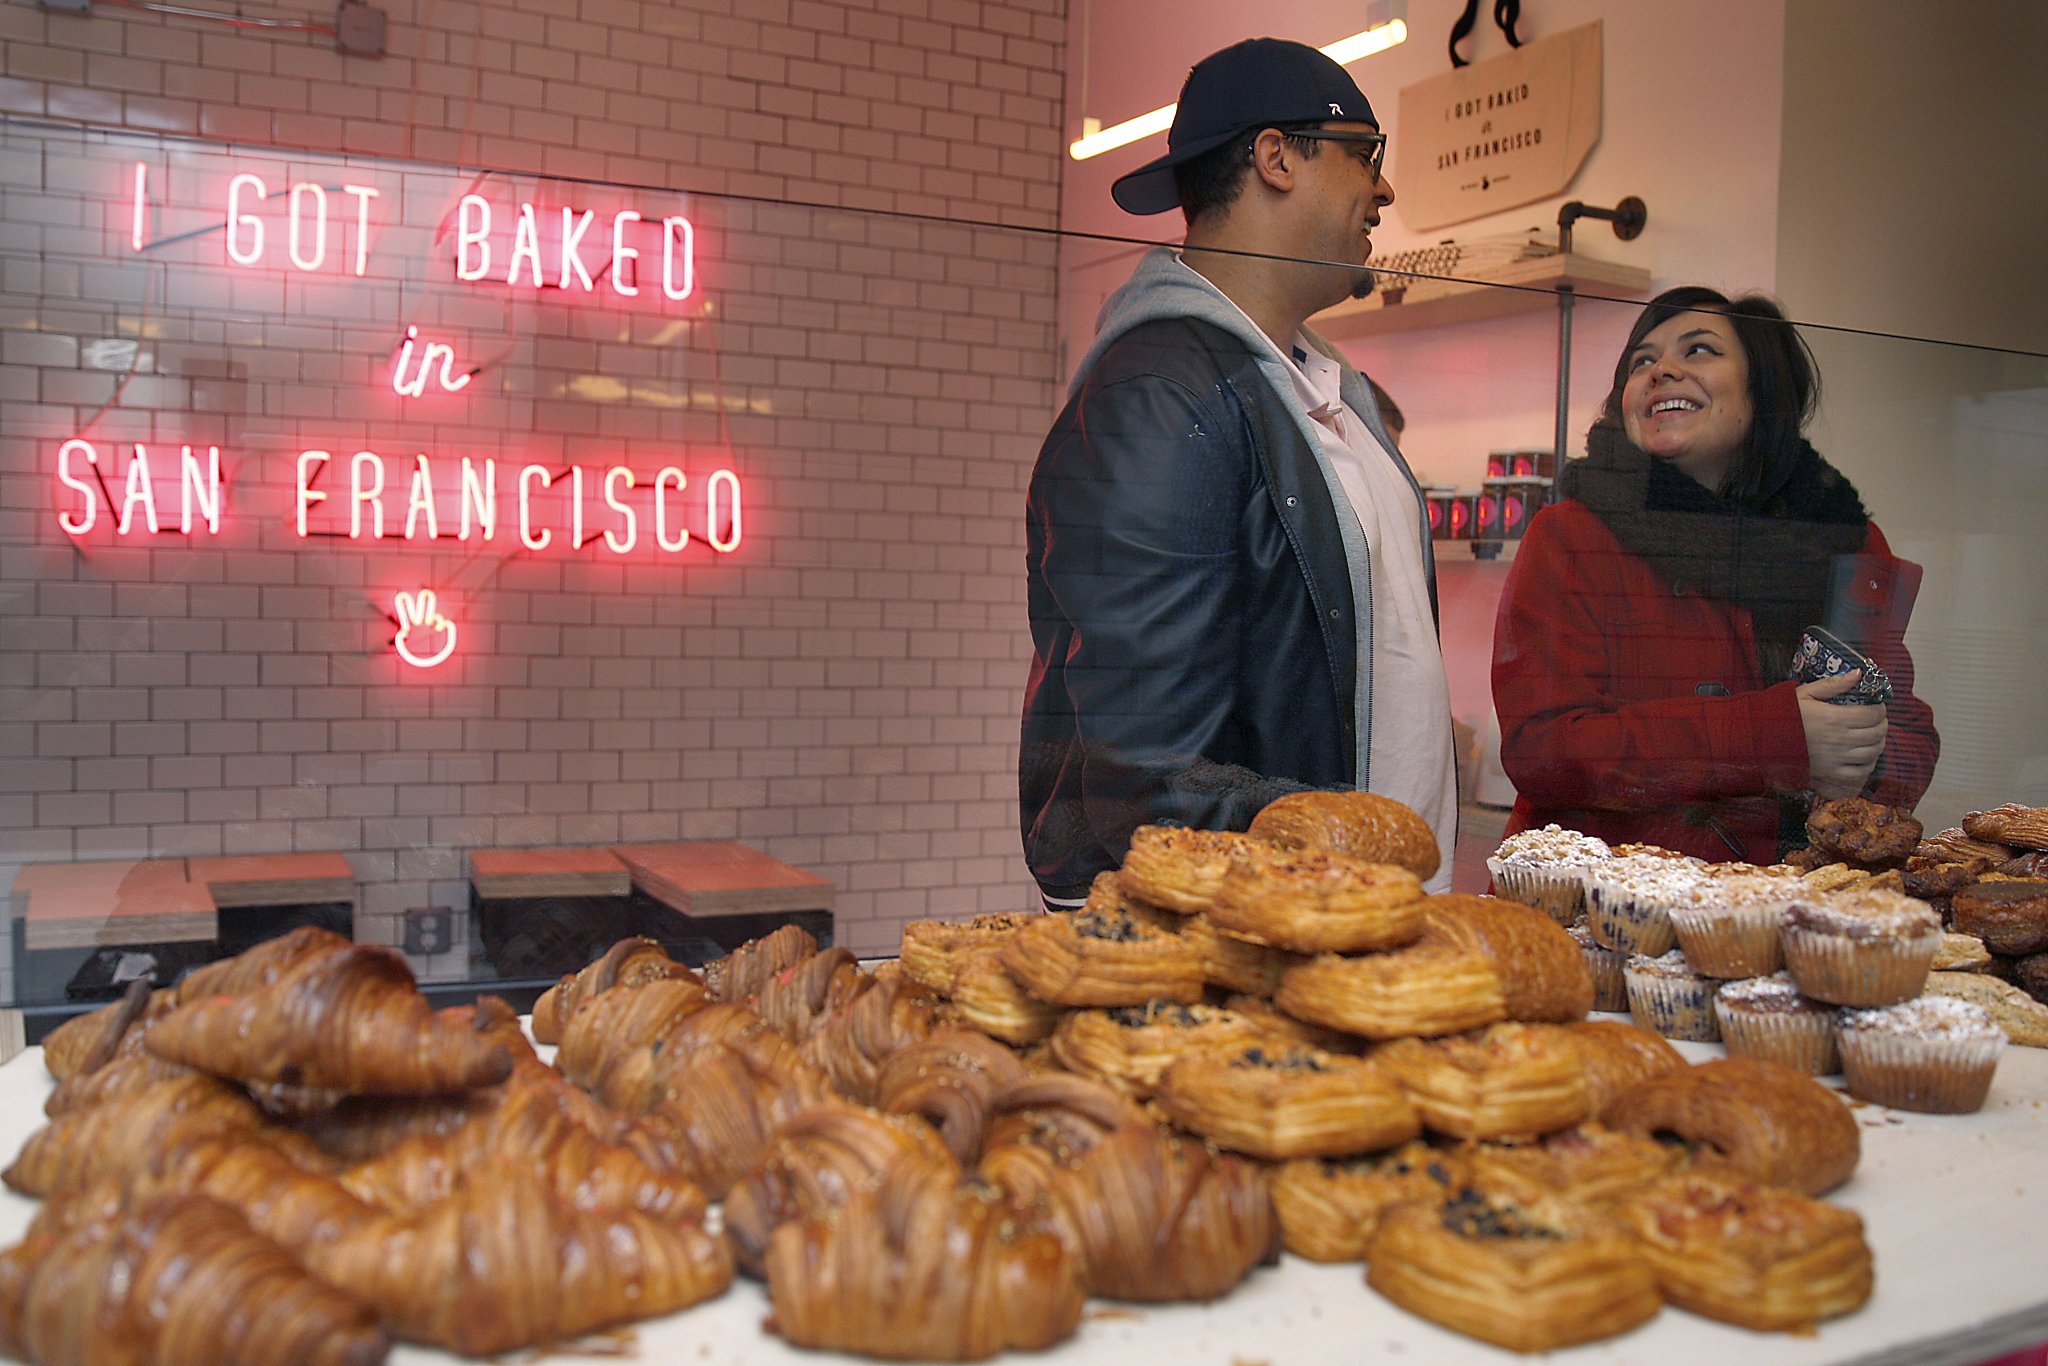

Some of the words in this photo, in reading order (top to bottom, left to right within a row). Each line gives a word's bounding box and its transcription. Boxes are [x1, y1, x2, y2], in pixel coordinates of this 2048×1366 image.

[1455, 98, 1482, 118] GOT
[1488, 84, 1529, 109] BAKED
[1438, 150, 1458, 170] SAN
[1464, 128, 1542, 162] FRANCISCO
[133, 161, 147, 252] I
[226, 173, 380, 277] GOT
[457, 194, 695, 301] BAKED
[393, 326, 470, 397] in
[57, 439, 221, 535] SAN
[296, 451, 744, 553] FRANCISCO
